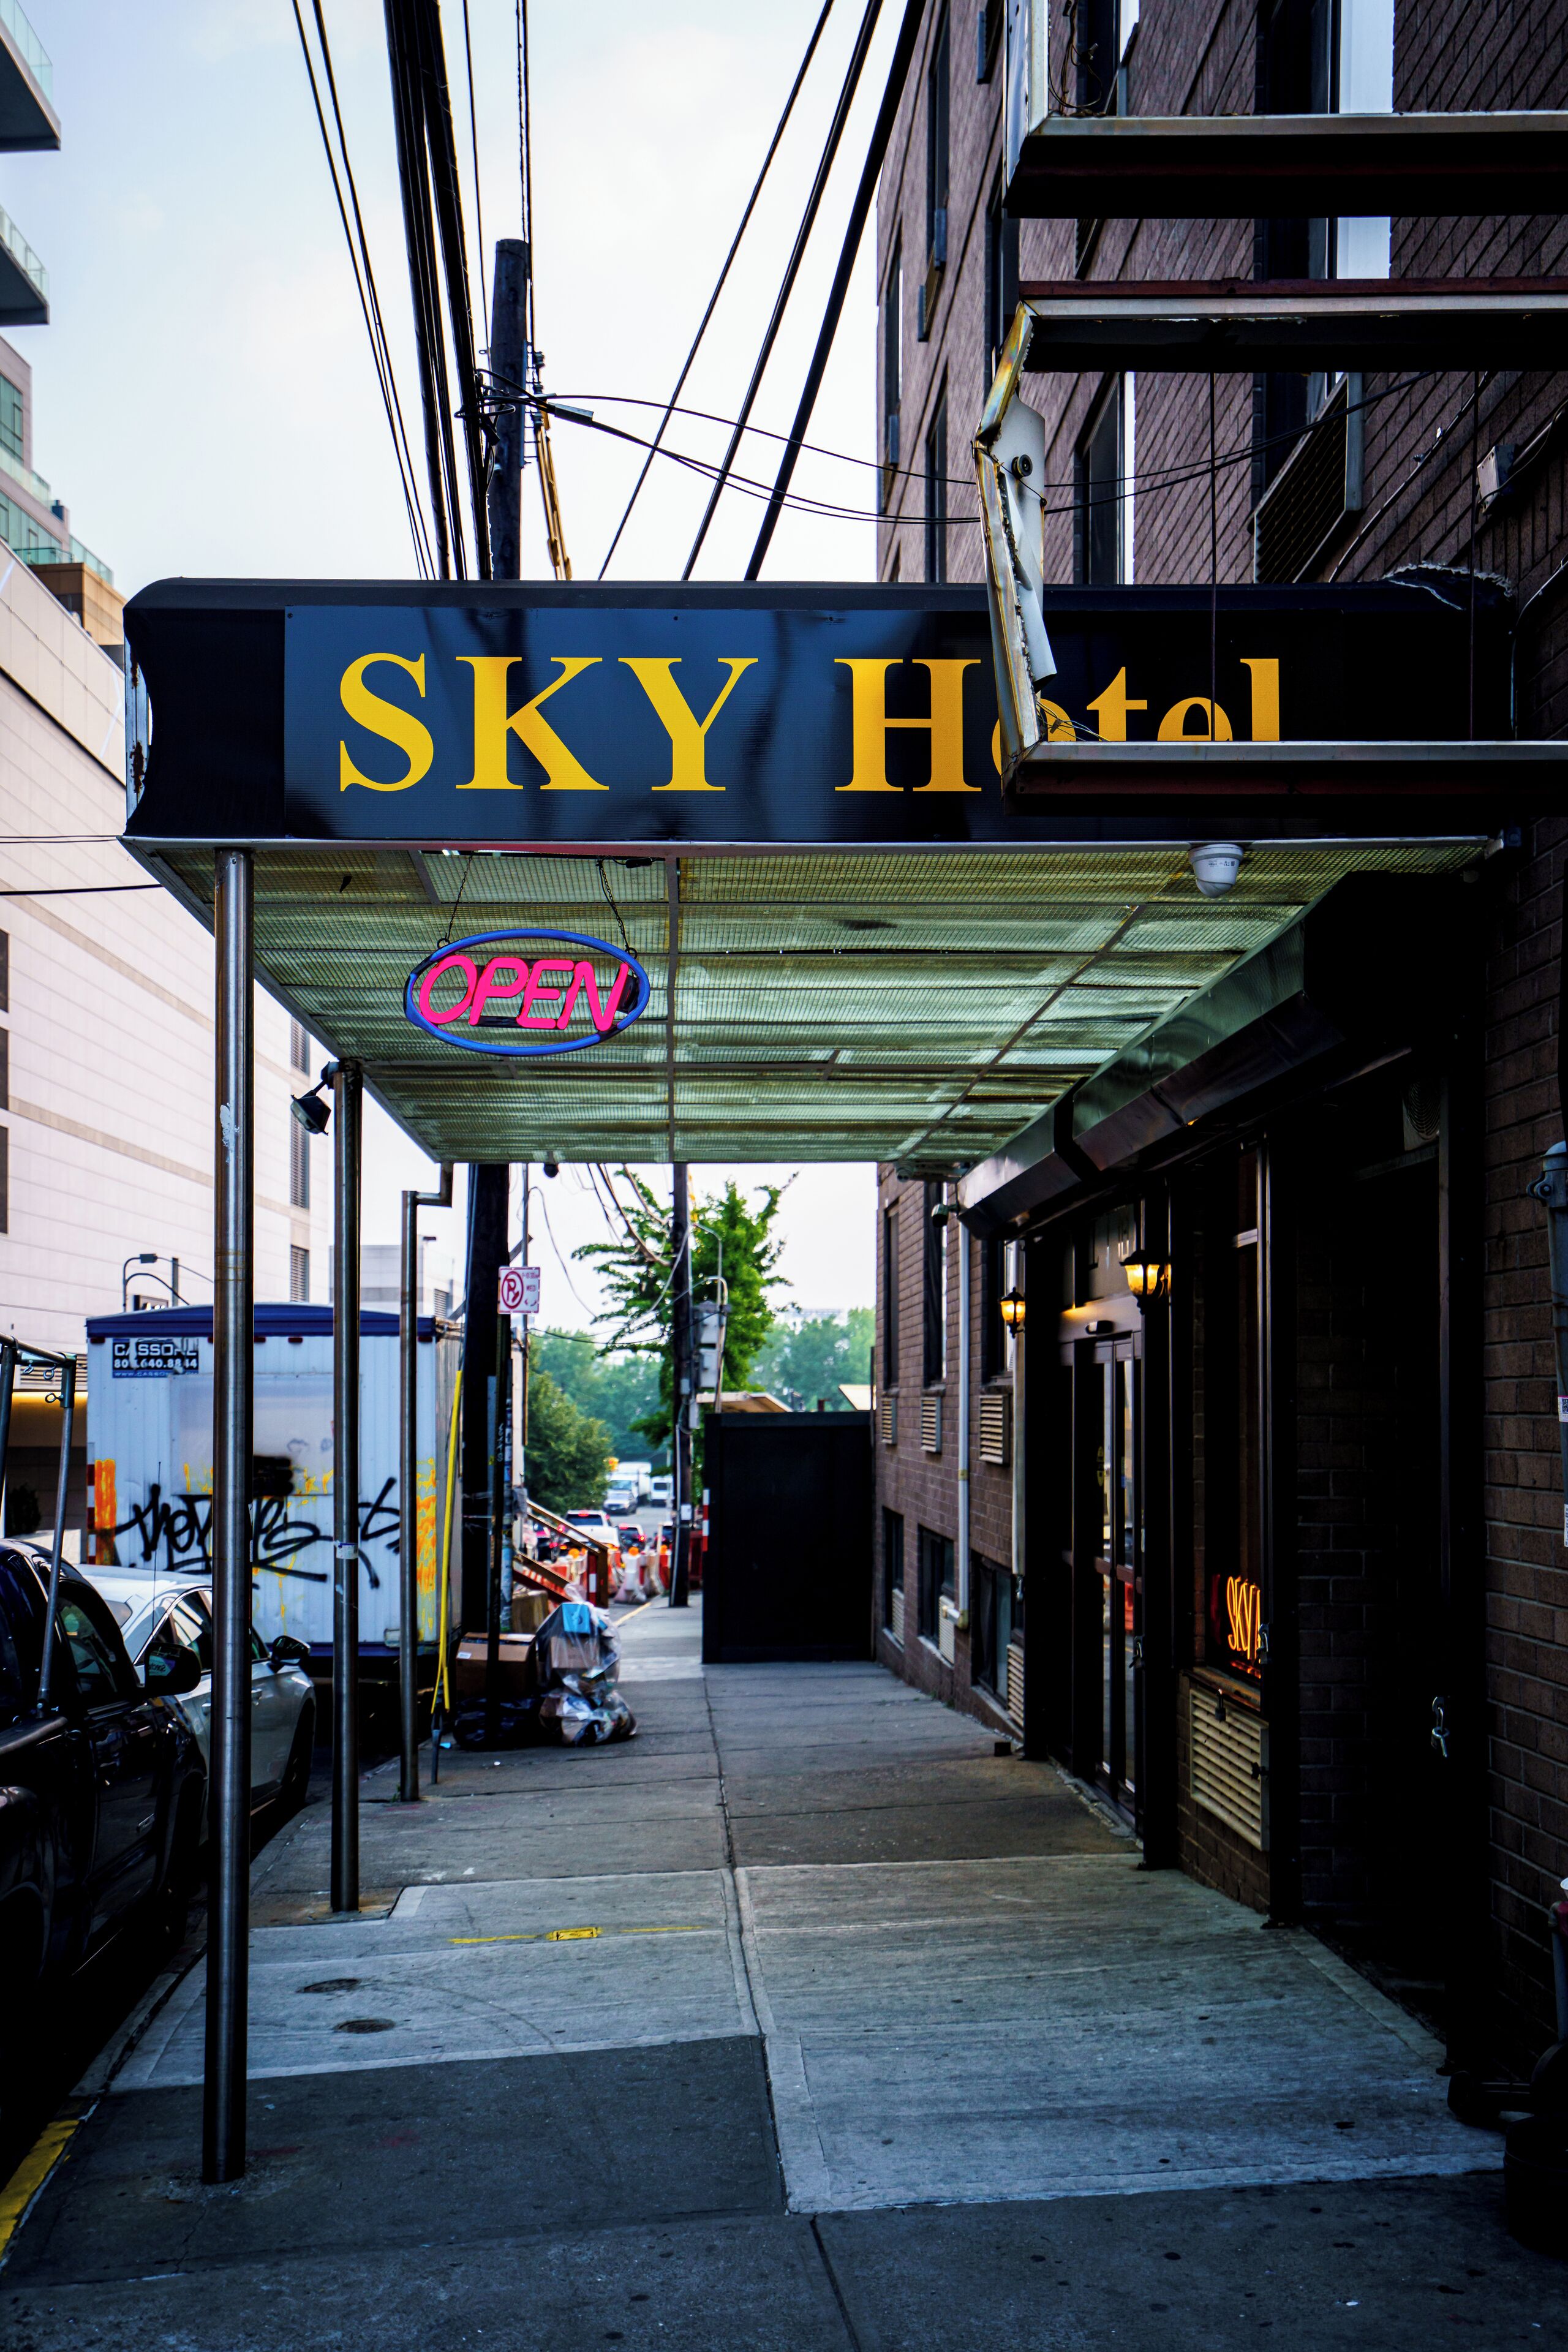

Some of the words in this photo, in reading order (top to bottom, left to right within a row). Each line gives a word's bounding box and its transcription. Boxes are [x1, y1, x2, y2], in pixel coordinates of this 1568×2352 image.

[340, 652, 758, 792] SKY
[419, 954, 628, 1032] OPEN
[114, 1359, 197, 1368] 80.640.884
[1227, 1576, 1254, 1660] SKY
